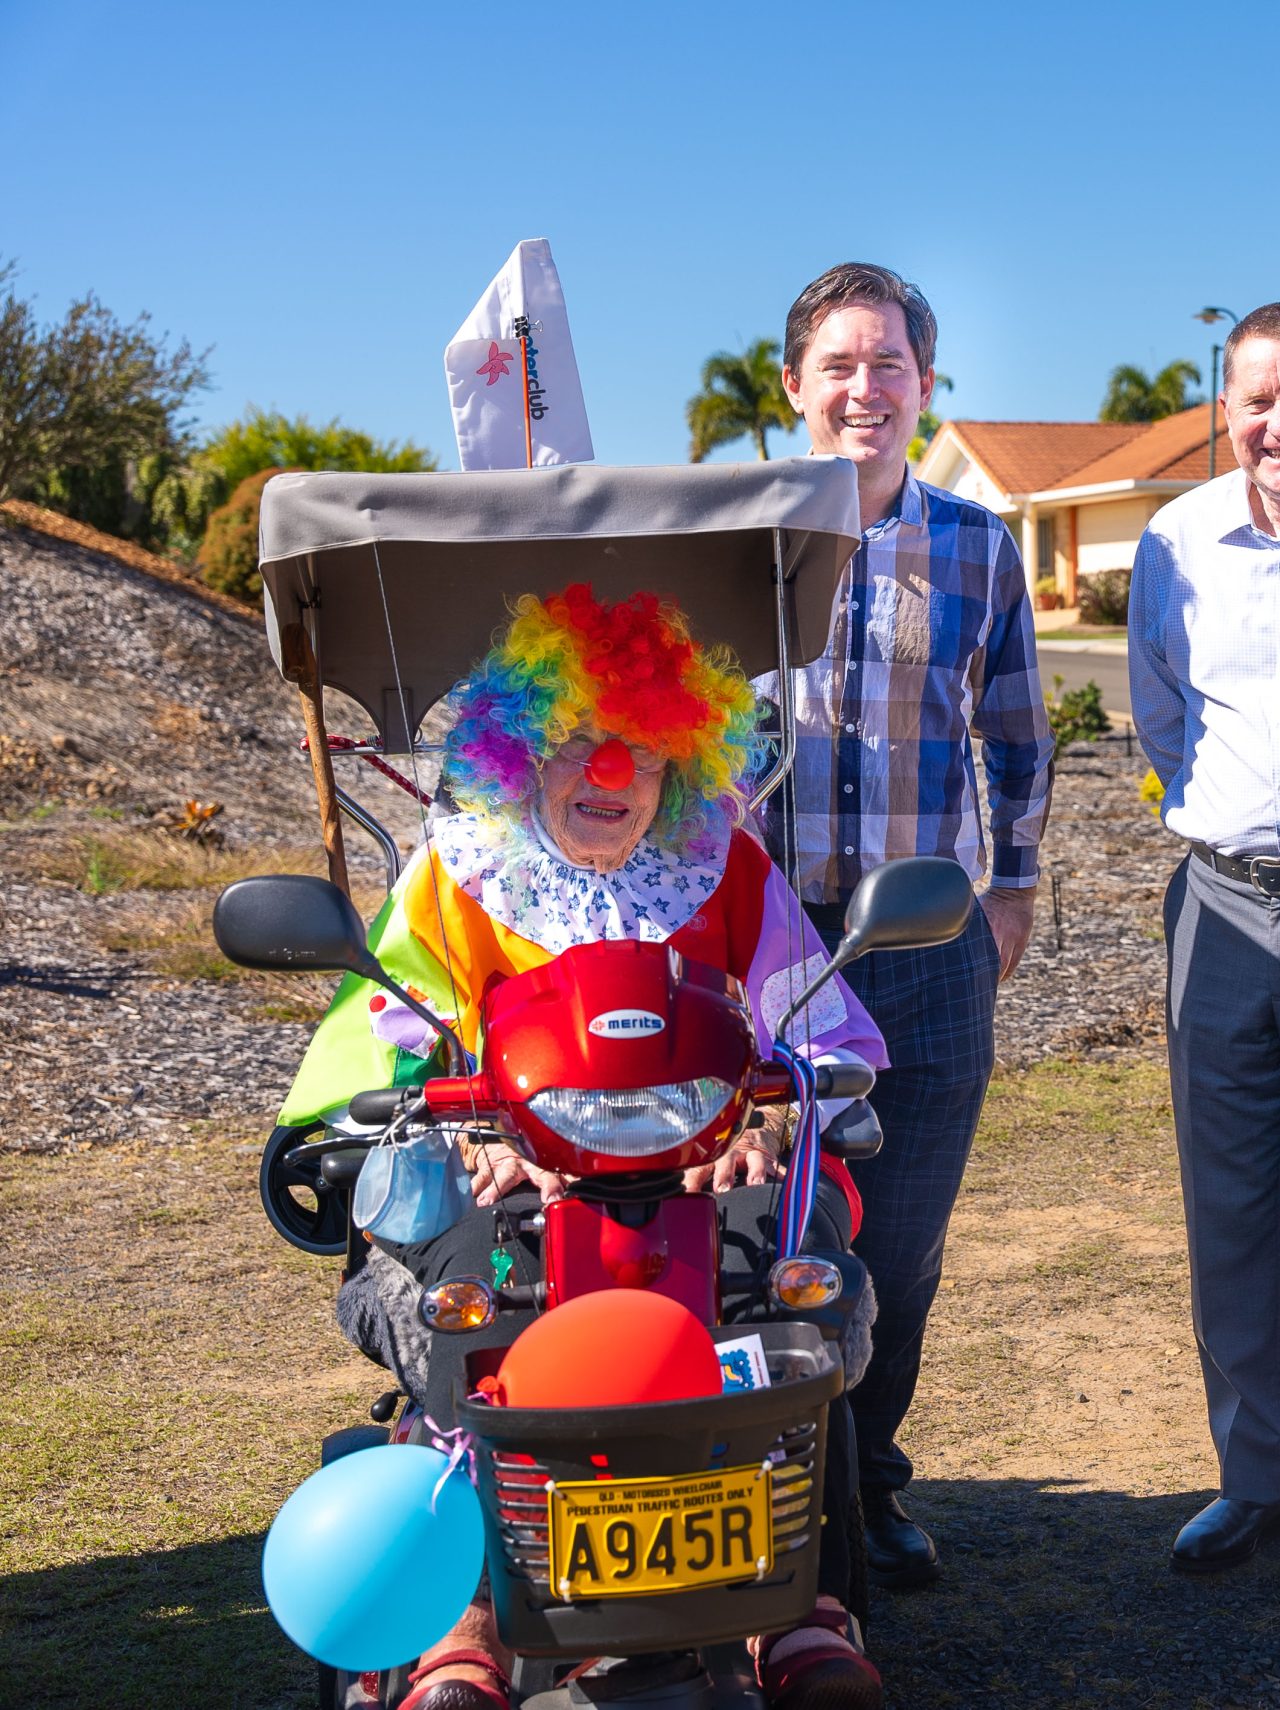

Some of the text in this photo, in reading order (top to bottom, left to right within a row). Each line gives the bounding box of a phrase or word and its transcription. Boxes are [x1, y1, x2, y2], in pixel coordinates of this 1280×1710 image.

[608, 1016, 662, 1029] merits
[567, 1487, 754, 1517] PEDESTRIAN TRAFFIC ROUTES ONLY
[623, 1488, 670, 1500] MOTORISED
[673, 1481, 722, 1496] WHEELCHAIR
[566, 1506, 754, 1582] A945R
